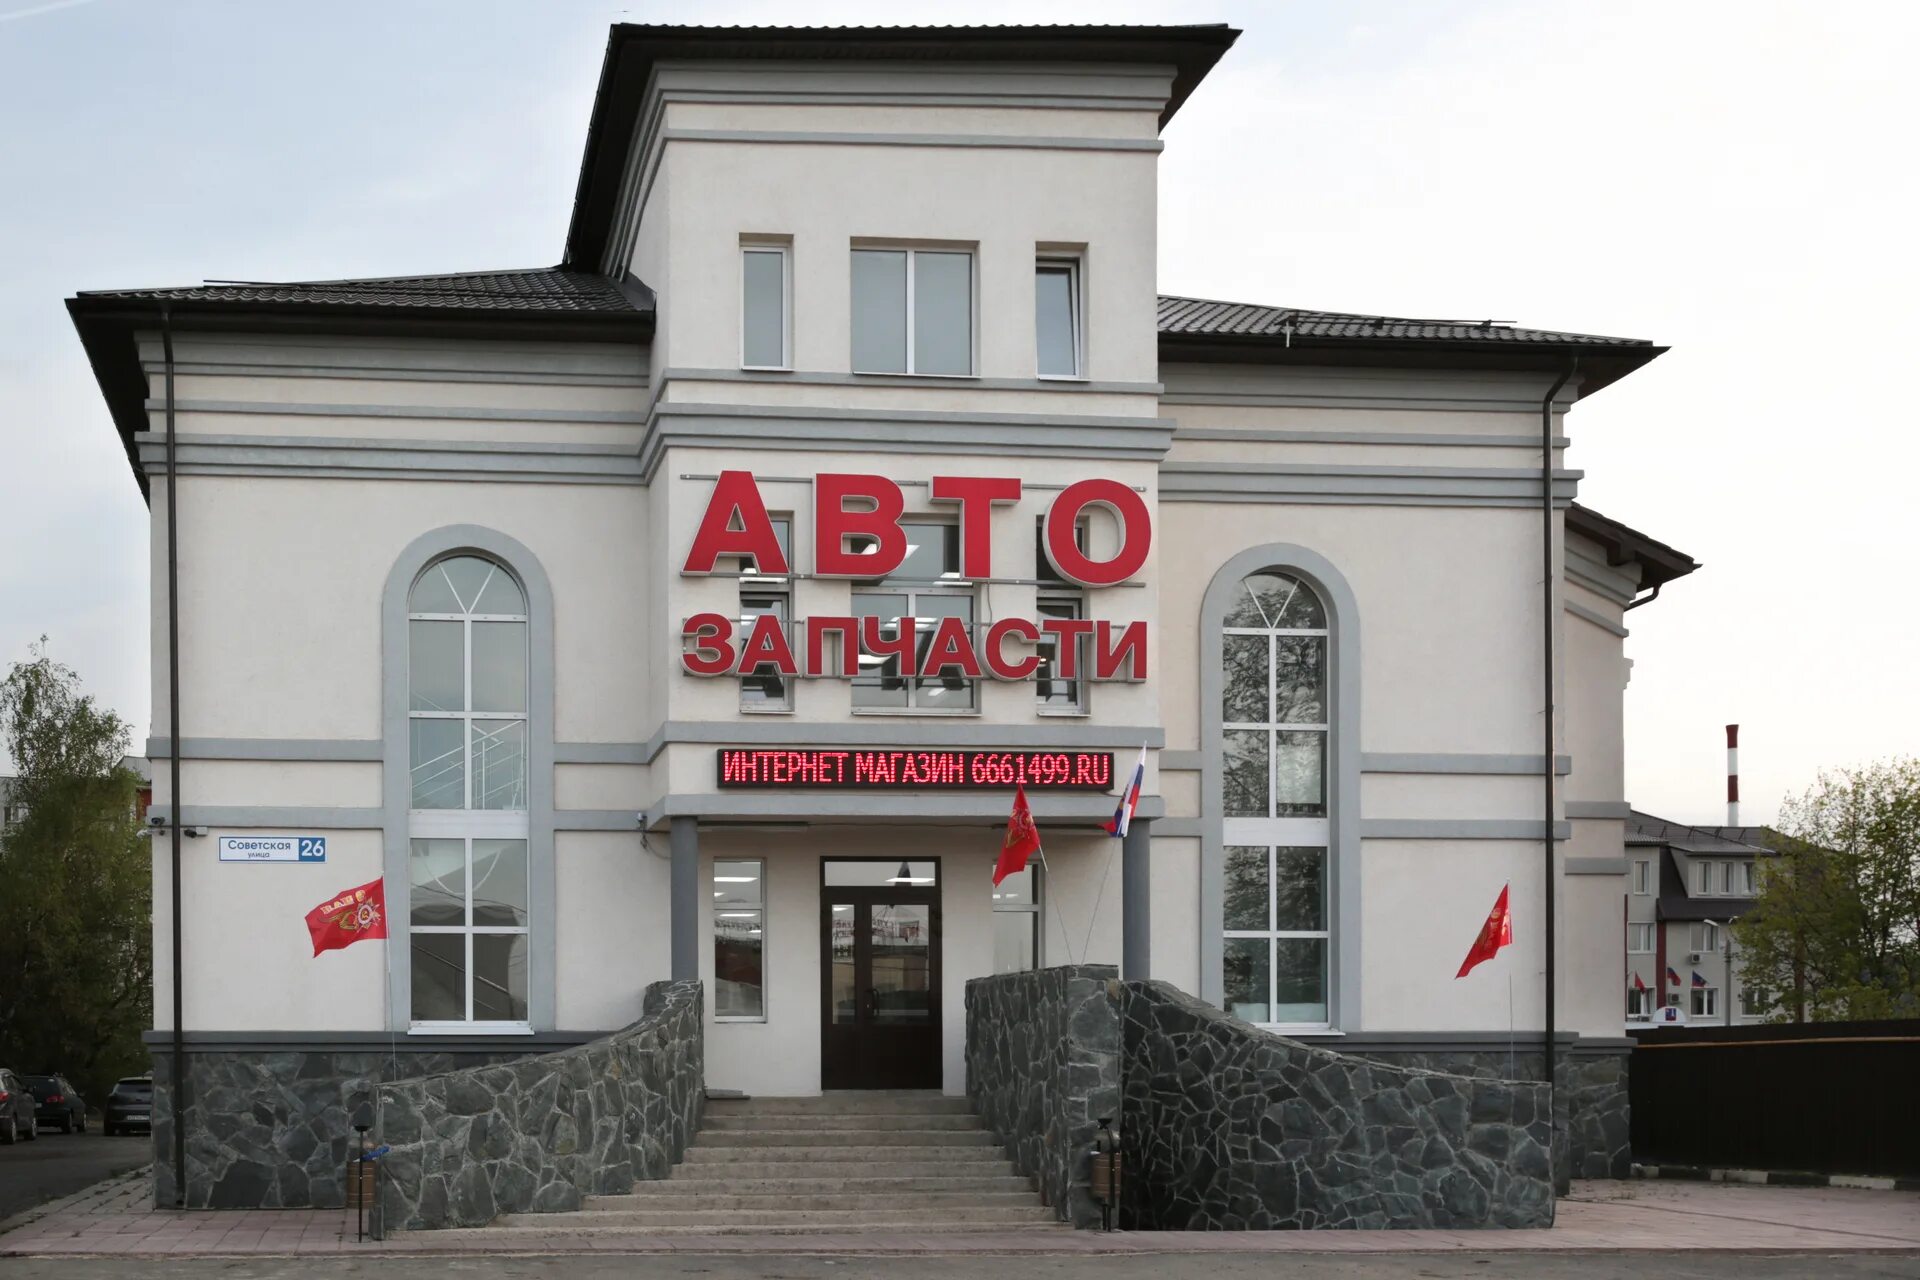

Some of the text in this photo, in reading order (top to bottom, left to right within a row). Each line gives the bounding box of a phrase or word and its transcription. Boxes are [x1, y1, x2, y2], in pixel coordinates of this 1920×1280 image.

[681, 470, 1152, 588] АВТО
[681, 612, 1148, 682] ЗАПЧАСТИ
[723, 751, 1110, 785] ИНТЕРНЕТ МАГАЗИН 6661499.RU
[227, 839, 291, 850] Советская
[301, 839, 325, 857] 26
